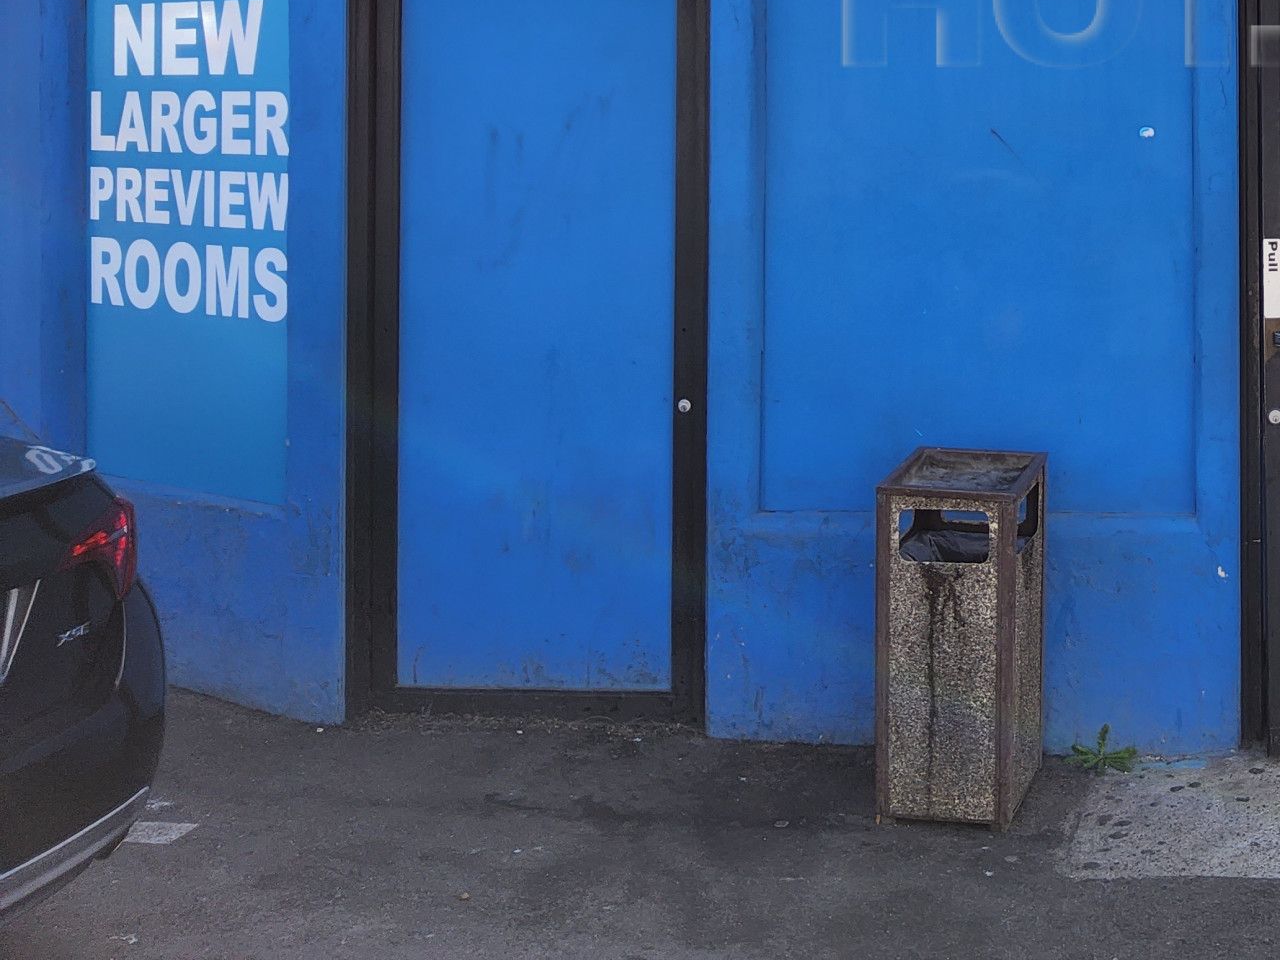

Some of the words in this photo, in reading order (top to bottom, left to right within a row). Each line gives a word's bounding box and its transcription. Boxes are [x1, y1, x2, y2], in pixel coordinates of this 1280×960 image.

[90, 90, 289, 157] LARGER
[90, 166, 289, 231] PREVIEW
[91, 236, 288, 323] ROOMS
[1267, 241, 1279, 272] Pull
